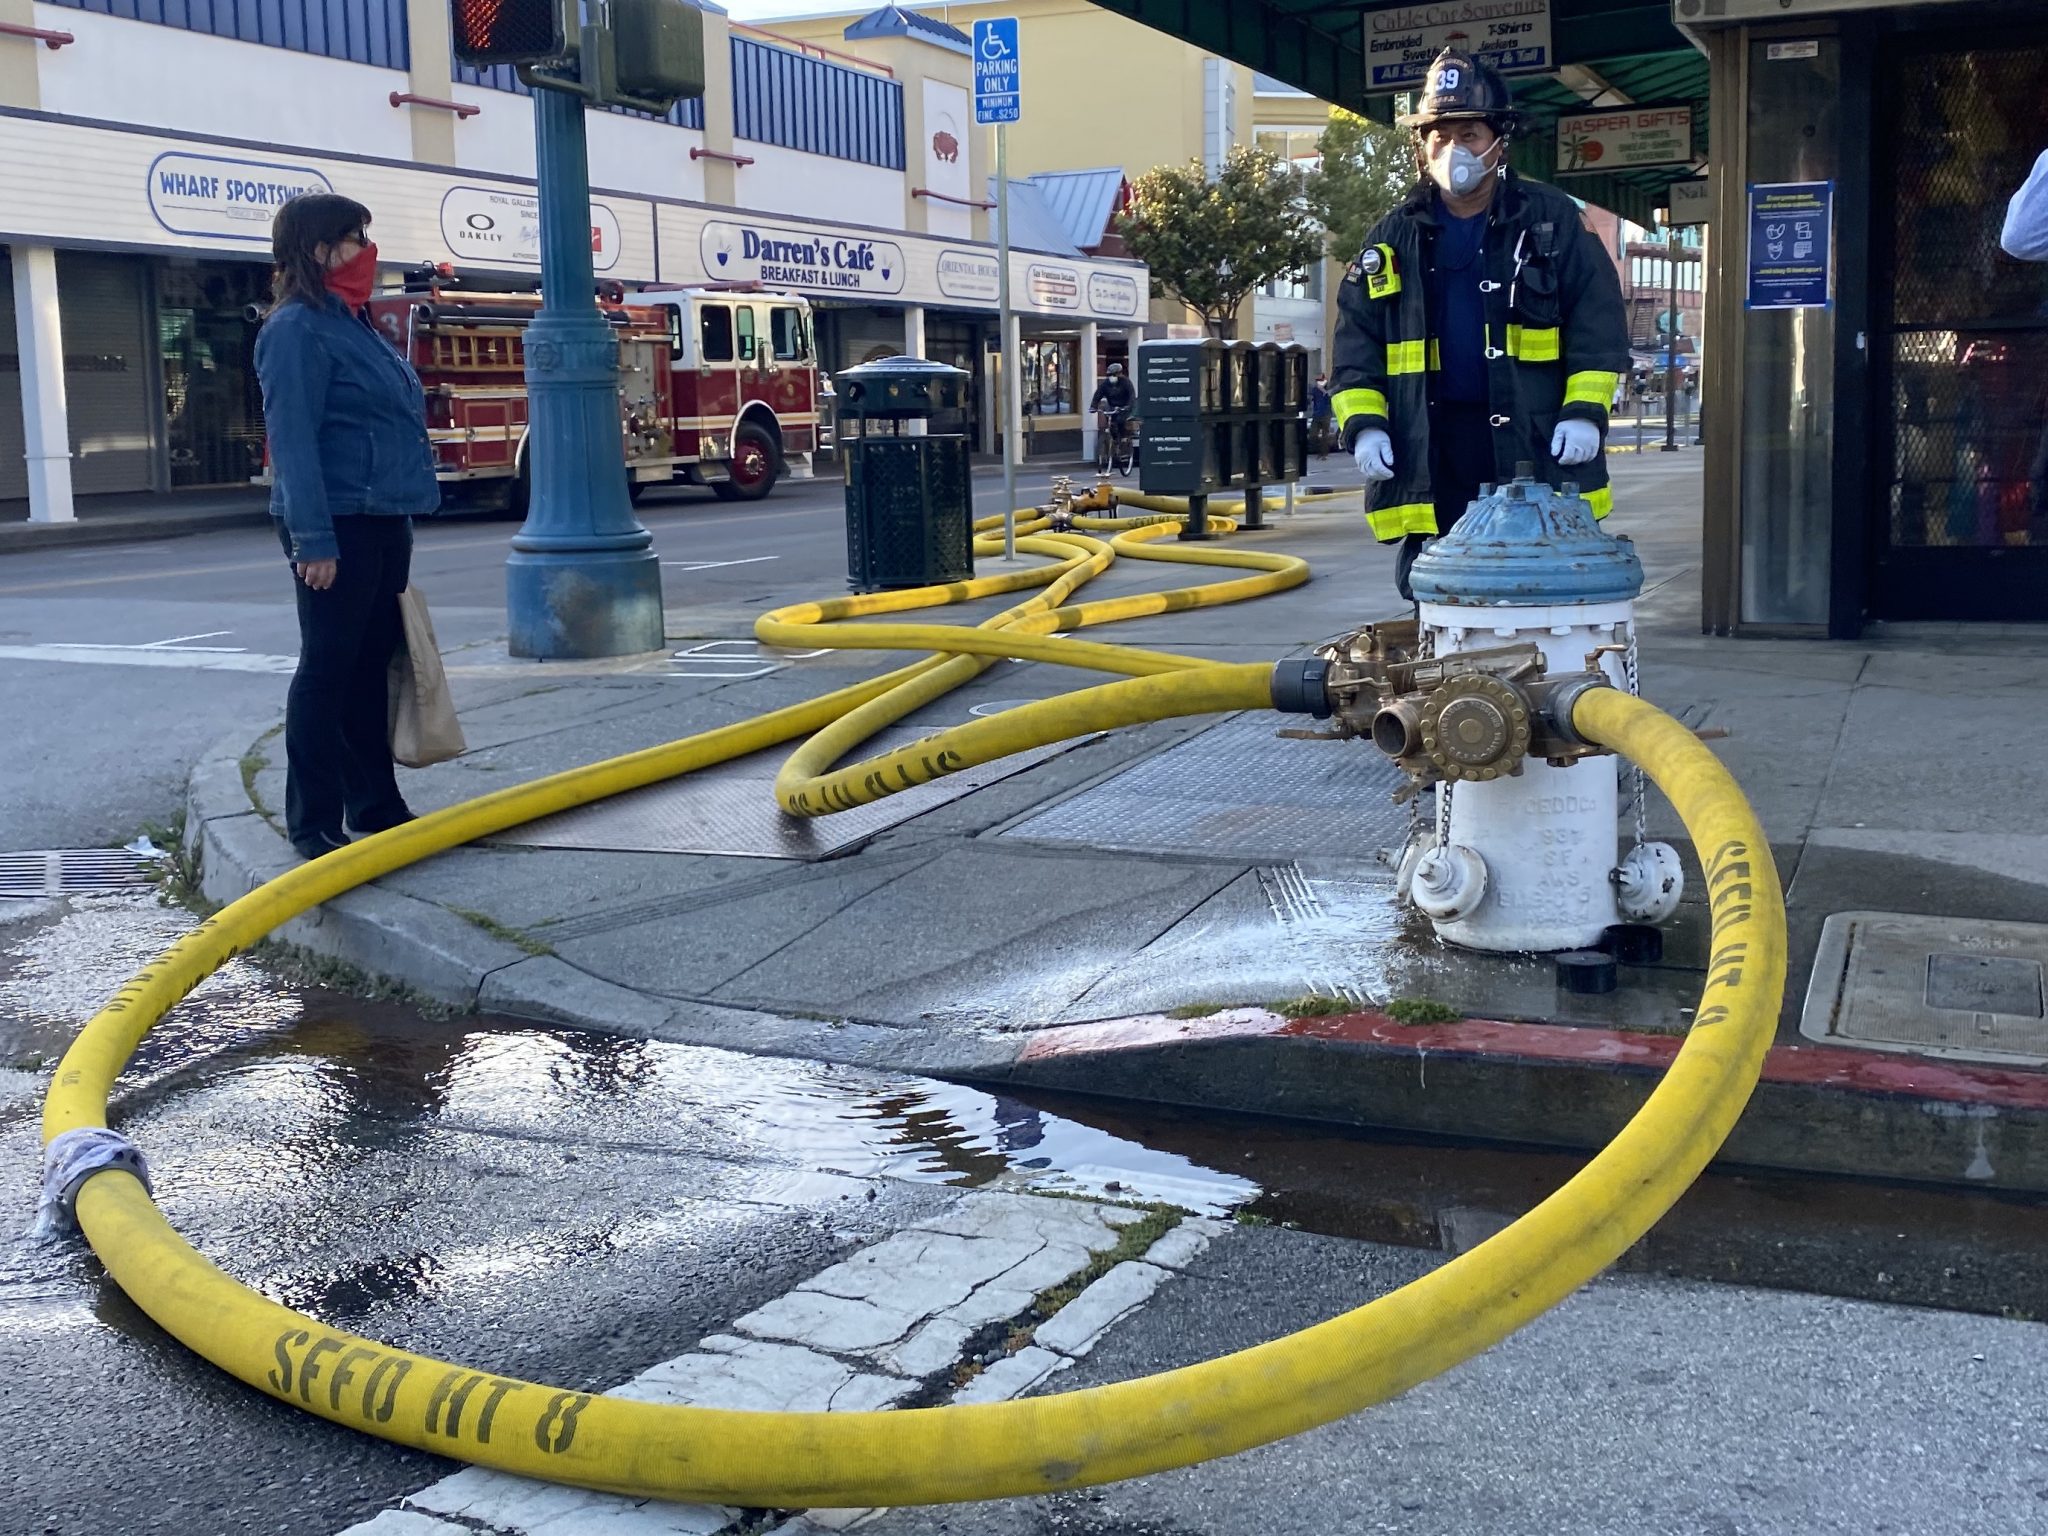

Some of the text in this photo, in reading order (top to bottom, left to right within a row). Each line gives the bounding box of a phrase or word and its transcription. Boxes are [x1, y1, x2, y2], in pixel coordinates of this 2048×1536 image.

[1488, 21, 1532, 36] T-Shirts
[976, 58, 1017, 77] PARKING
[984, 76, 1009, 93] ONLY
[1436, 68, 1459, 91] 39
[982, 96, 1013, 108] MINIMUM
[977, 109, 993, 121] FINE
[1561, 111, 1689, 135] JASPER GIFTS
[159, 171, 219, 199] WHARF
[489, 195, 509, 205] ROYAL
[459, 230, 502, 242] OAKLEY
[741, 228, 875, 271] Darren's Café
[941, 259, 976, 275] ORIENTAL
[760, 265, 860, 288] BREAKFAST & LUNCH
[268, 1328, 414, 1424] SFFD
[534, 1391, 592, 1454] 8
